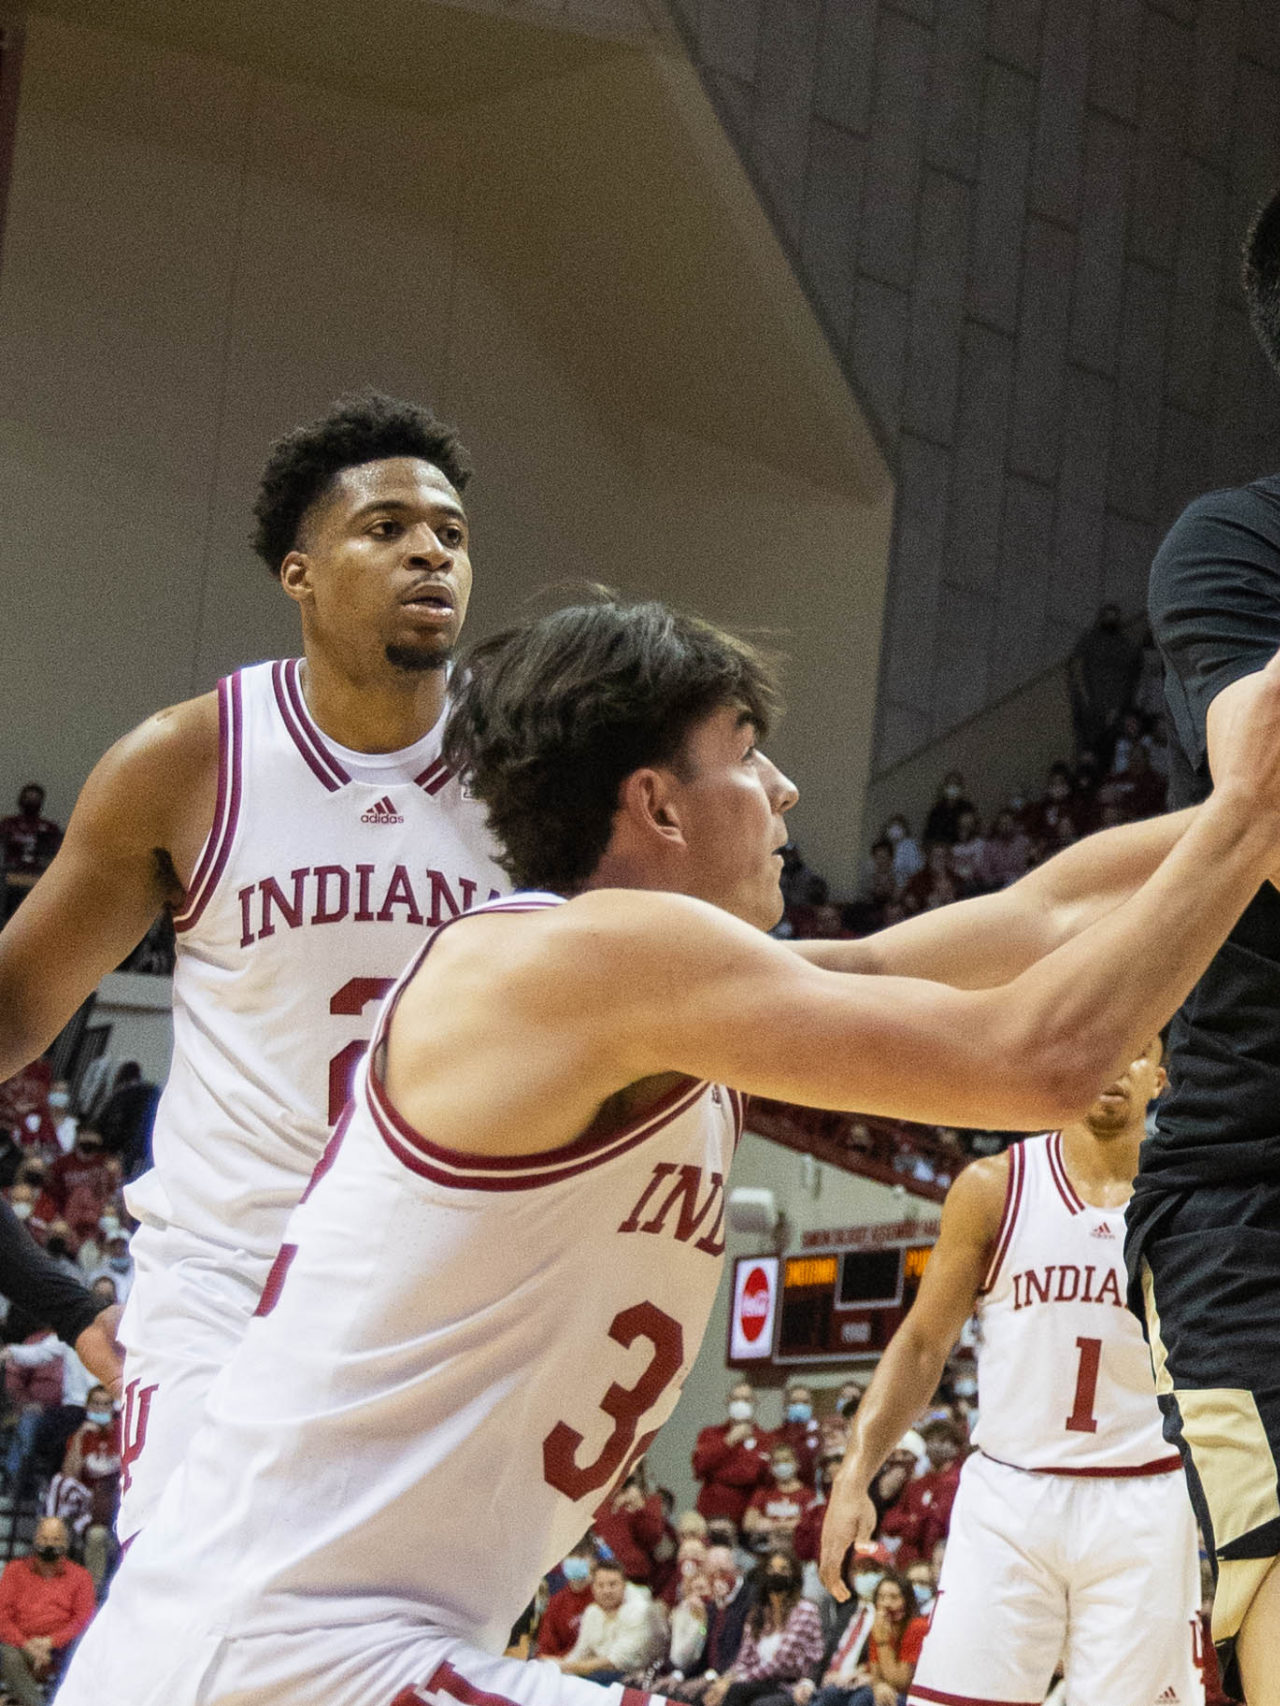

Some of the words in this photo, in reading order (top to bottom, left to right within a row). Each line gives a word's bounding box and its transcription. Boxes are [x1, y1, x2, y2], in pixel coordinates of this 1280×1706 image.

[360, 813, 404, 824] adidas
[238, 864, 501, 949] INDIAN
[1013, 1265, 1128, 1310] INDIA
[543, 1300, 683, 1502] 3
[1066, 1337, 1101, 1433] 1
